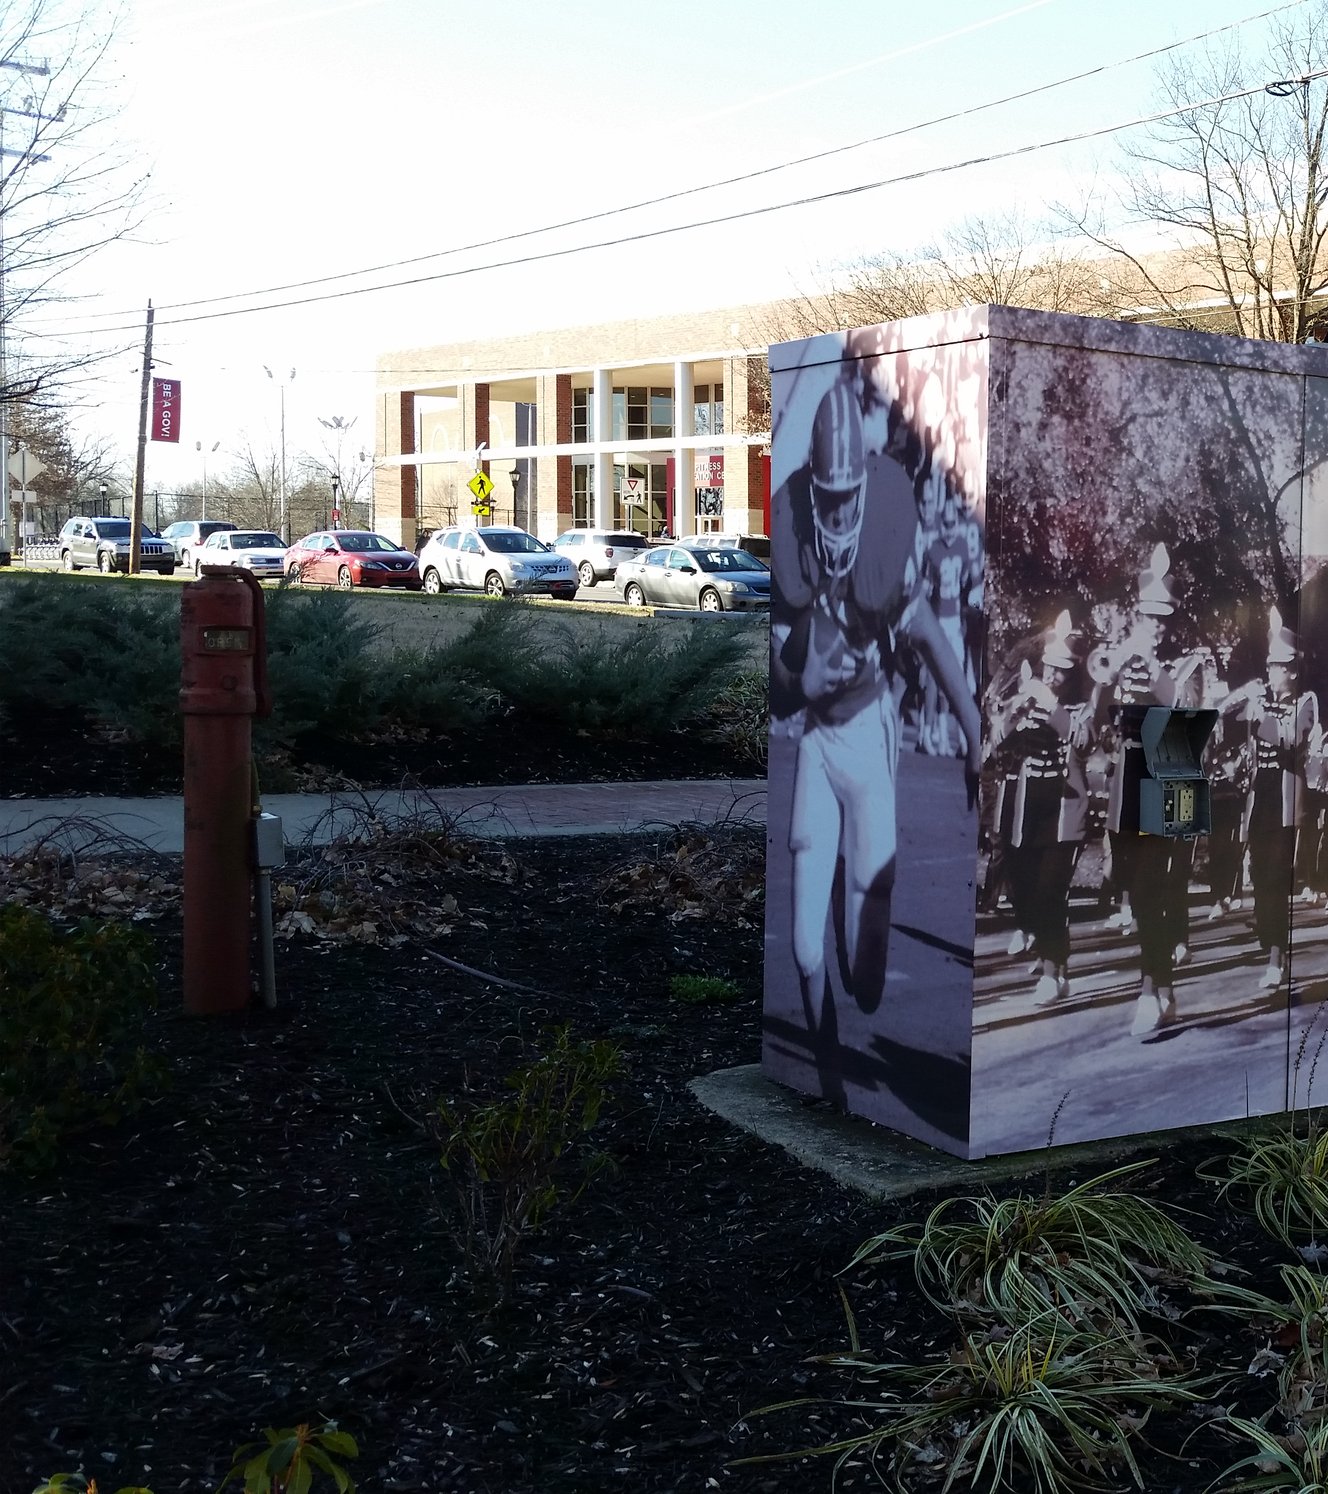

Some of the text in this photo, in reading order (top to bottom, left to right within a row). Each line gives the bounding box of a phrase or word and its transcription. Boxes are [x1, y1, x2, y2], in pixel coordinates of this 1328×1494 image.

[161, 383, 172, 438] BE A GOV!
